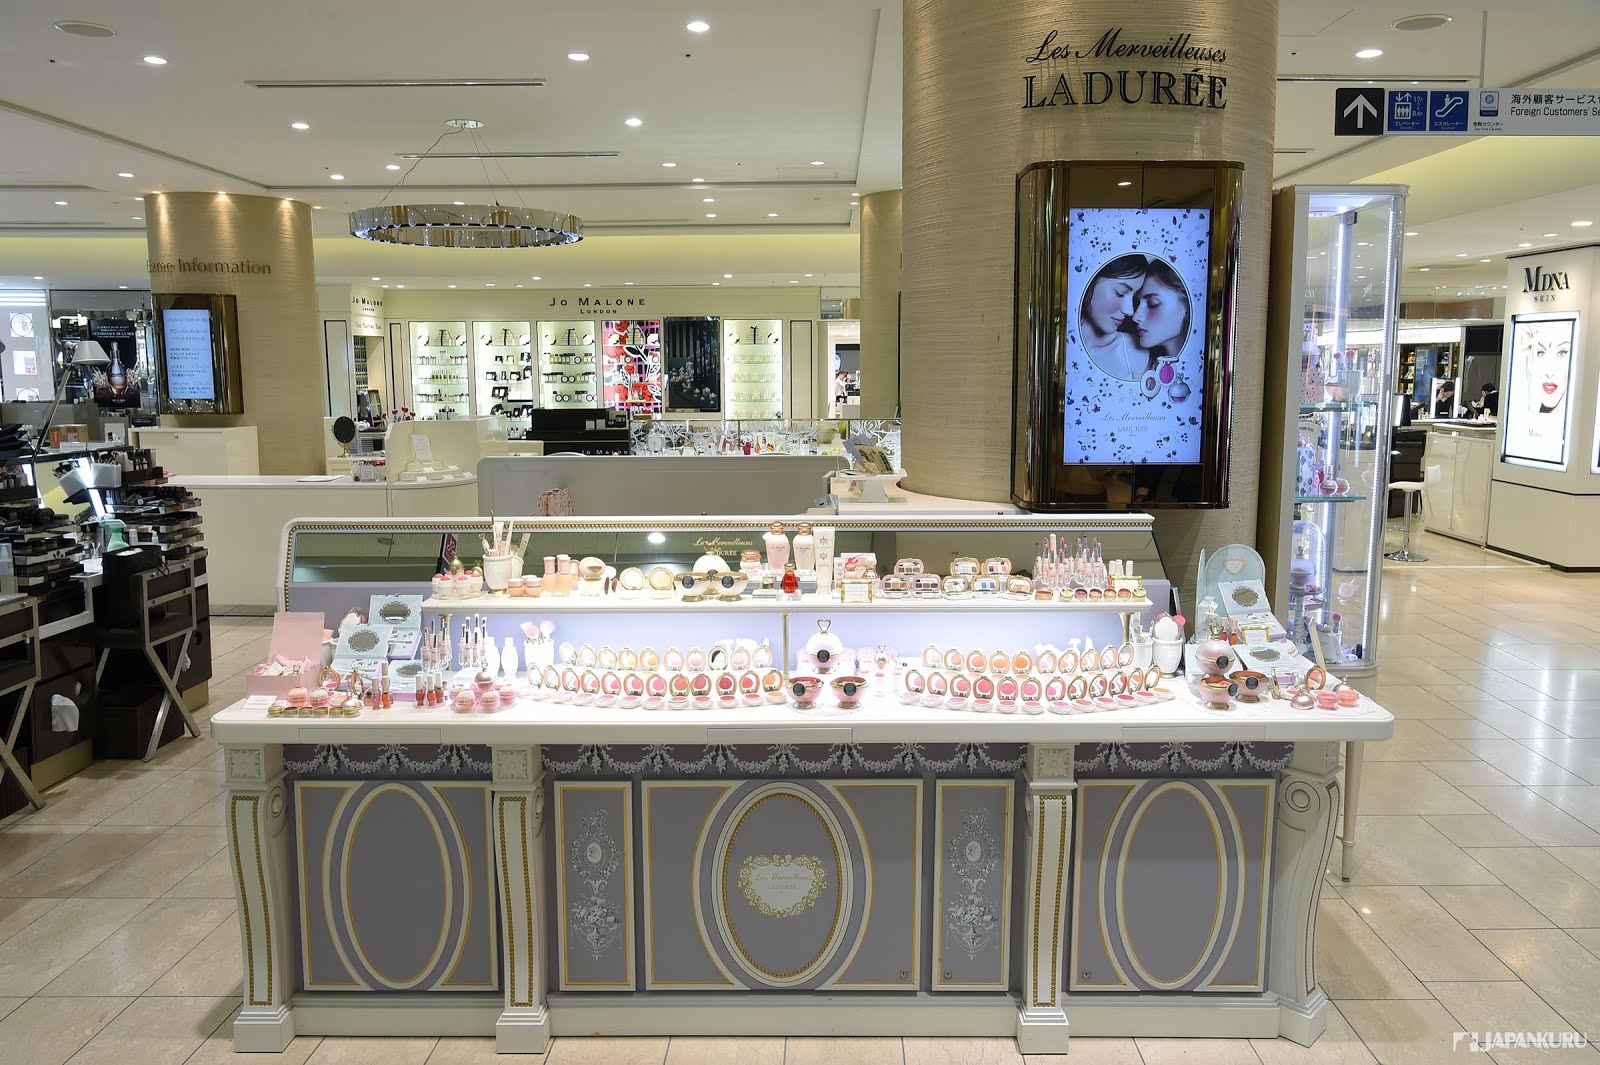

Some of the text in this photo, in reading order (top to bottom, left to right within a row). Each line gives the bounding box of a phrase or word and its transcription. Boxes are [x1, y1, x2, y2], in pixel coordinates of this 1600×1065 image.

[1026, 27, 1227, 63] Les Merveilleuses
[1021, 68, 1227, 109] LADURÉE
[1511, 94, 1600, 104] 海外顧客サービス
[1511, 107, 1541, 117] Foreign
[1544, 107, 1590, 116] Customers'
[178, 258, 271, 274] Information
[1522, 266, 1570, 292] MDNA
[549, 297, 645, 306] JO MALONE
